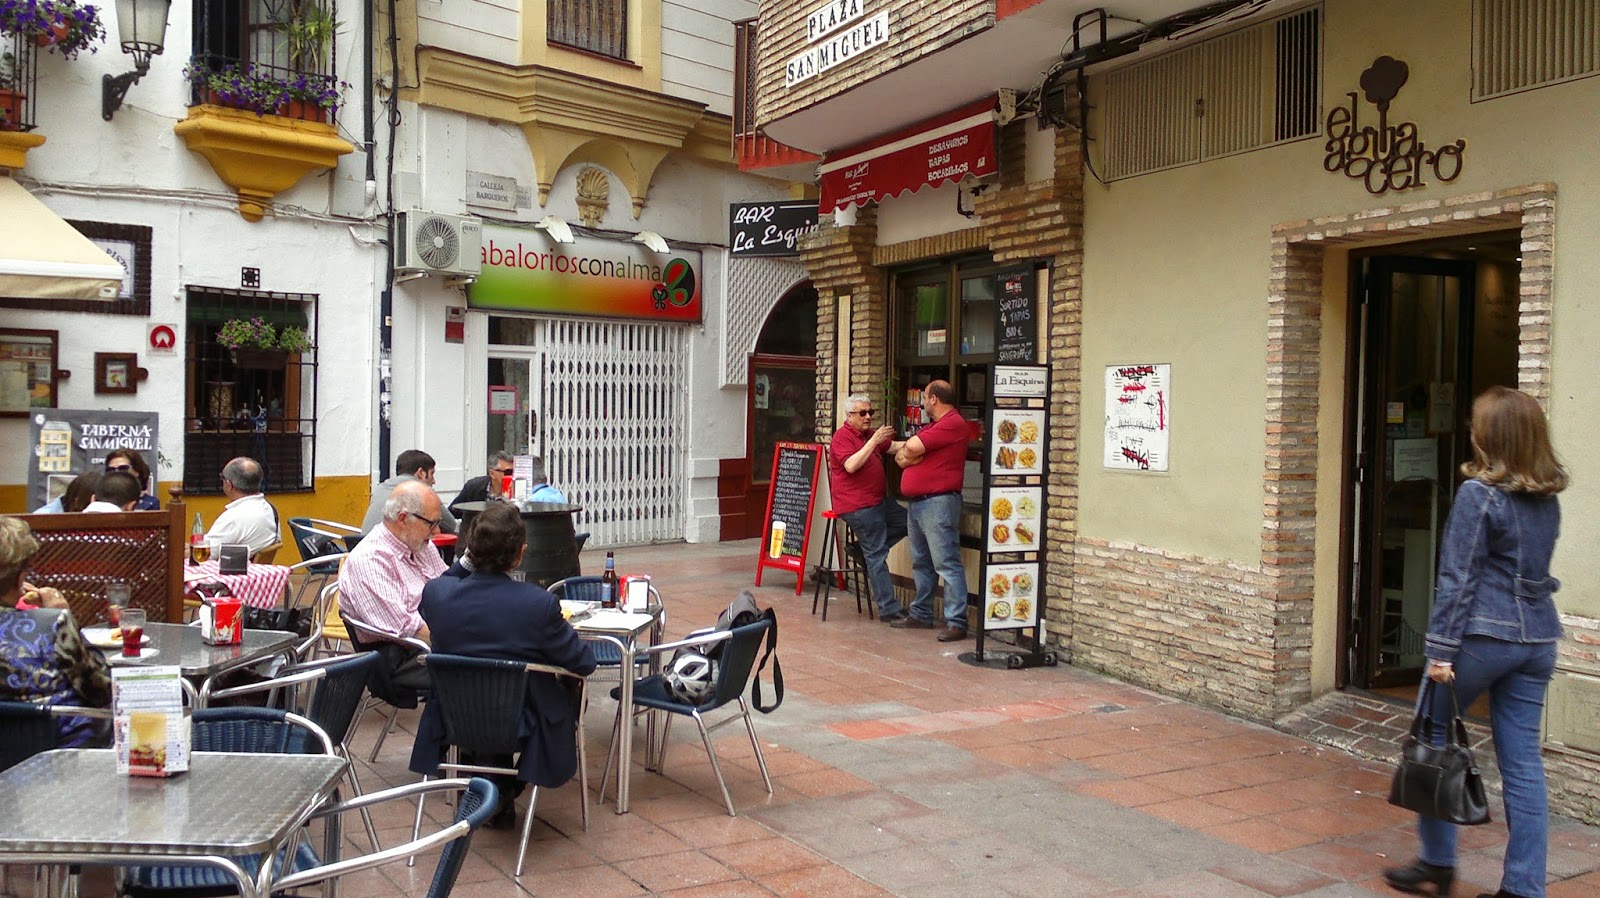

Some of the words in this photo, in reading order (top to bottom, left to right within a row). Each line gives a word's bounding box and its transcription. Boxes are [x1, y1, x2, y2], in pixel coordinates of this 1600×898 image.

[808, 0, 860, 38] PLAZA
[787, 53, 814, 83] SAN
[819, 19, 884, 69] MIGUEL
[928, 153, 951, 169] TAPAS
[479, 181, 505, 192] CALLEJA
[476, 191, 509, 203] BARQUEROS
[733, 205, 775, 225] BAR
[732, 231, 755, 253] La
[760, 219, 820, 249] Esquin
[994, 374, 1008, 386] La
[1009, 375, 1045, 387] Esquina
[80, 423, 153, 438] TABERNA
